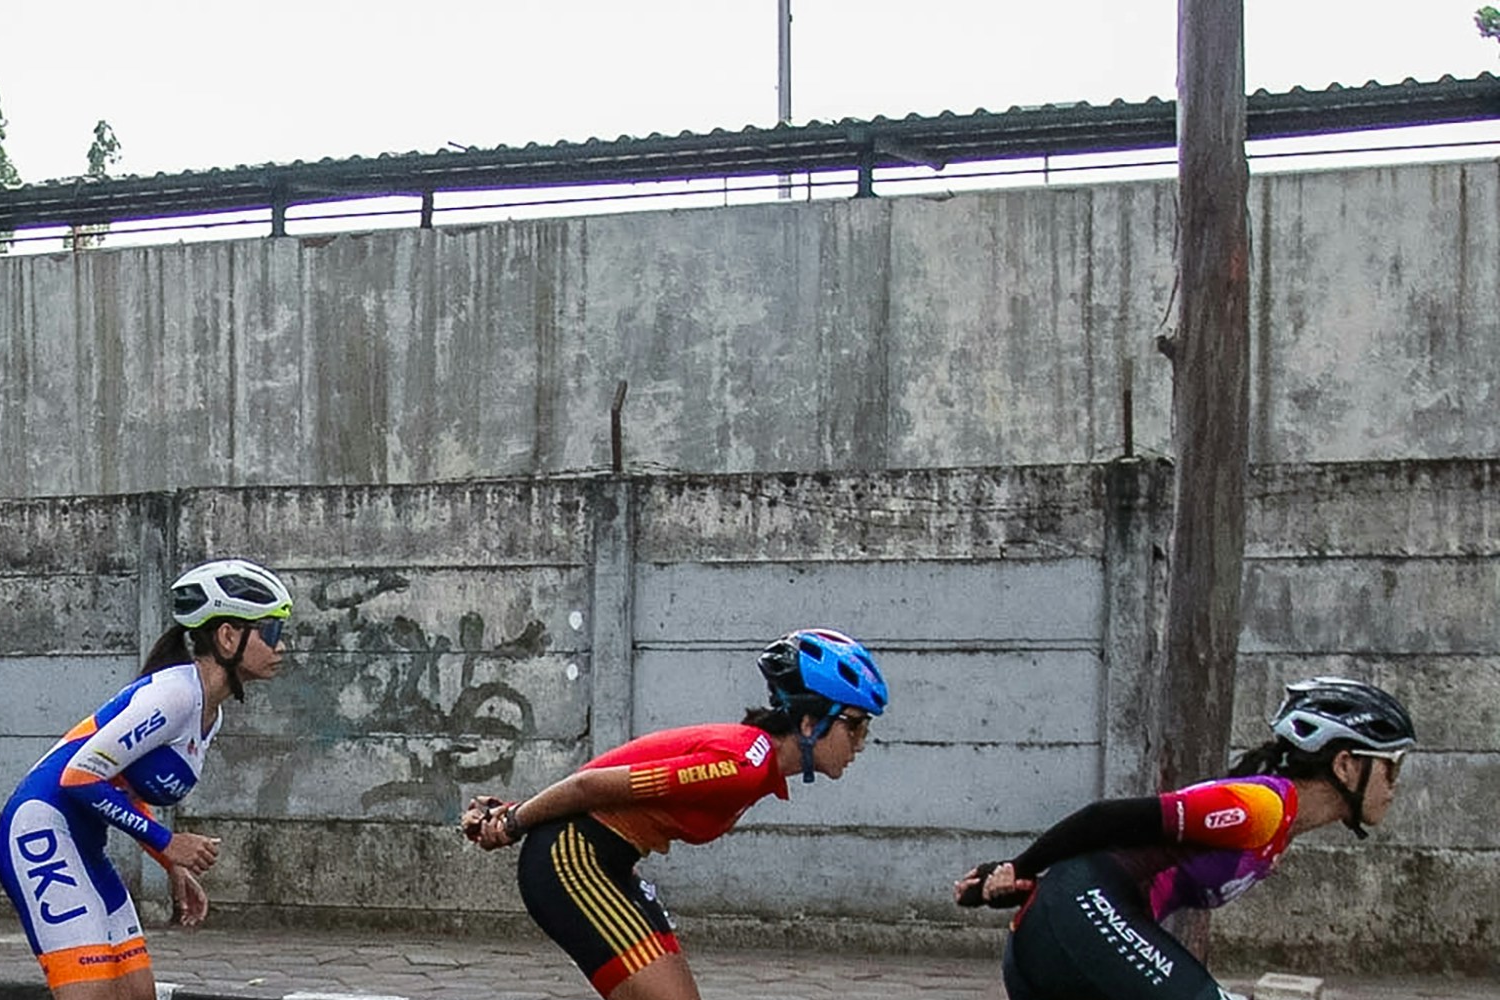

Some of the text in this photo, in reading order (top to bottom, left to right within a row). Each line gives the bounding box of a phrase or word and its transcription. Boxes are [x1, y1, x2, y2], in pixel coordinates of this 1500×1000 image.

[118, 708, 167, 750] TFS
[677, 759, 738, 785] BEKASI
[92, 799, 149, 832] JAKARTA
[1208, 809, 1243, 828] TFS
[16, 828, 88, 925] DKJ
[1087, 888, 1174, 977] MONASTANA
